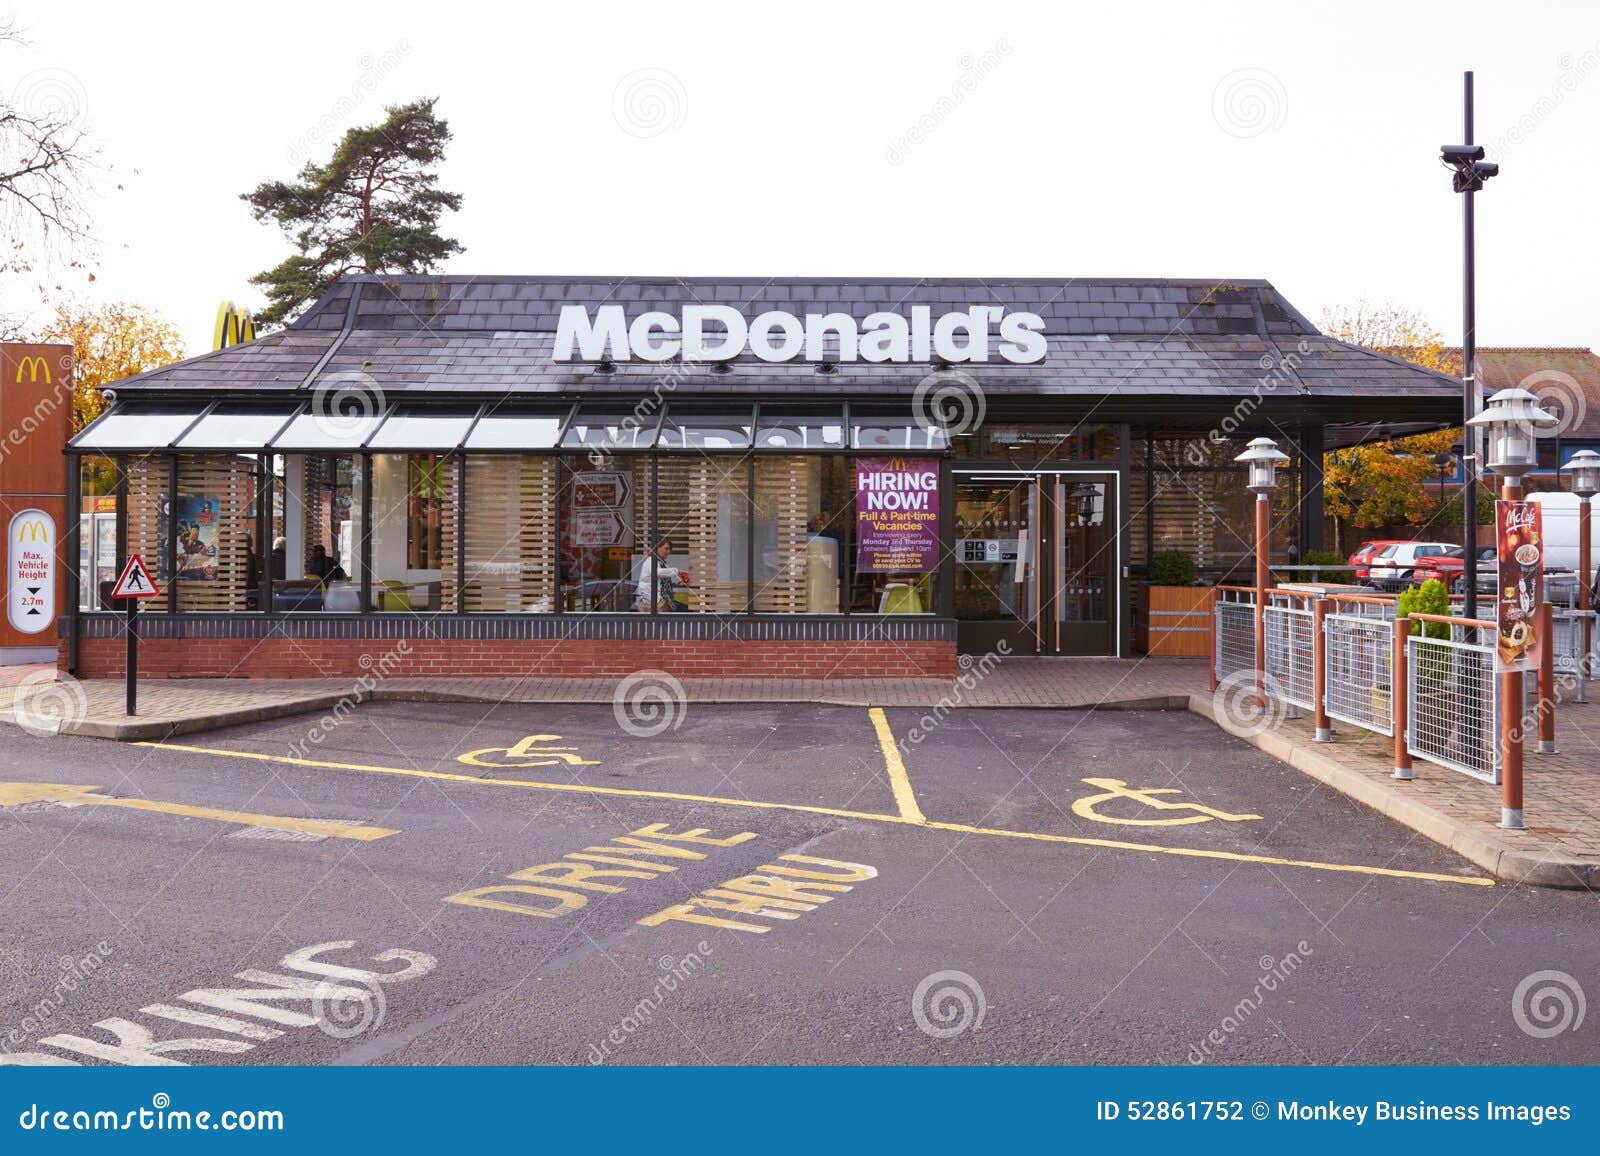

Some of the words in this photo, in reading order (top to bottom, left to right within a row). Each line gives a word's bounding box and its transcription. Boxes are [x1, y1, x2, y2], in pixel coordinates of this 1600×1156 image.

[552, 305, 1048, 364] McDonald's
[858, 472, 937, 491] HIRING
[867, 491, 928, 510] NOW!
[860, 511, 878, 521] Full
[880, 511, 887, 521] &
[890, 511, 937, 521] Part-time
[873, 521, 923, 531] Vacancies
[23, 552, 43, 560] Max.
[18, 561, 48, 570] Vehicle
[18, 571, 47, 580] Height
[21, 597, 43, 606] 2.7m
[443, 823, 759, 918] DRIVE
[636, 854, 878, 933] THRU
